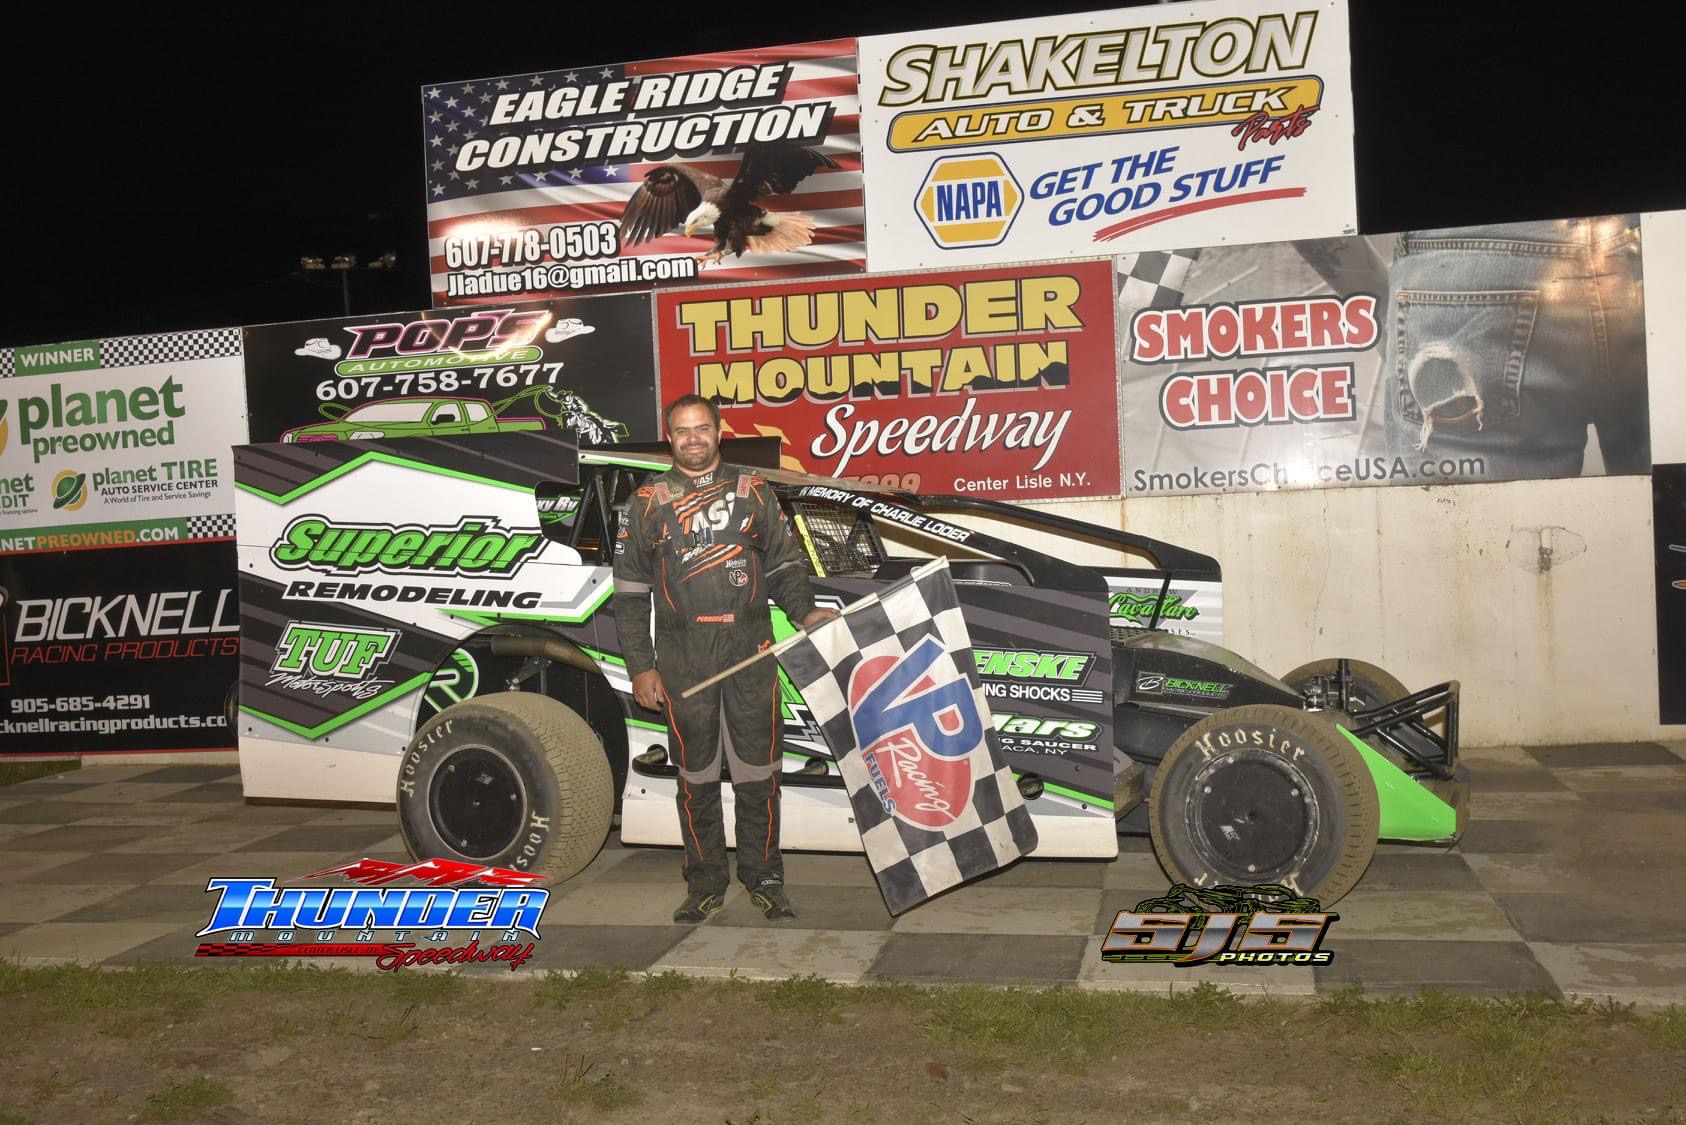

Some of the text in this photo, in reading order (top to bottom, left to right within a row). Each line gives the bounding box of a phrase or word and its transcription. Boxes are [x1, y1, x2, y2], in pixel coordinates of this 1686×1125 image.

[878, 10, 1318, 107] SHAKELTON
[489, 61, 794, 126] EAGLE RIDGE
[912, 85, 1298, 143] AUTO & TRUCK
[455, 102, 834, 173] CONSTRUCTION
[1231, 103, 1322, 151] Parts
[1030, 146, 1180, 200] GET THE
[1048, 155, 1285, 226] GOOD STUFF
[936, 181, 1001, 222] NAPA
[446, 224, 618, 269] 607-778-0503
[448, 256, 694, 297] Jladue16@gmail.com
[343, 308, 551, 360] POPS
[676, 275, 1086, 354] THUNDER
[1132, 295, 1379, 363] SMOKERS
[20, 348, 95, 368] WINNER
[348, 349, 530, 373] AUTOMOTIVE
[697, 341, 1070, 406] MOUNTAIN
[316, 362, 564, 401] 607-758-7677
[1162, 364, 1355, 428] CHOICE
[18, 375, 186, 445] planet
[33, 421, 175, 463] preowned
[810, 397, 1073, 478] Speedway
[92, 458, 218, 491] planet TIRE
[101, 479, 218, 496] AUTO SERVICE CENTER
[110, 495, 129, 504] World
[130, 495, 137, 503] of
[136, 494, 150, 502] Tire
[151, 493, 163, 501] and
[164, 491, 187, 500] Service
[188, 490, 211, 499] Savings
[954, 472, 1091, 493] Center Lisle N.Y.
[807, 486, 854, 503] MEMORY
[852, 496, 874, 509] OF
[870, 502, 924, 527] CHARLIE
[924, 520, 971, 543] LODER
[273, 518, 545, 573] Superior
[284, 580, 543, 609] REMODELING
[1127, 586, 1178, 596] ANDRW
[15, 589, 240, 642] BICKNELL
[11, 637, 240, 664] RACING PRODUCTS
[276, 624, 394, 678] TUF
[972, 650, 1089, 680] ENSKE
[11, 694, 151, 714] 905-685-4291
[264, 672, 396, 699] Motorsports
[852, 637, 983, 758] VP
[1009, 685, 1071, 702] SHOCKS
[1166, 678, 1234, 693] BICKNELL
[400, 719, 454, 798] Hoosier
[1001, 745, 1068, 756] ACA, NY
[1020, 739, 1097, 751] SAUCER
[1195, 728, 1306, 762] Hoosier
[864, 753, 897, 816] FUELS
[875, 737, 958, 821] Racing
